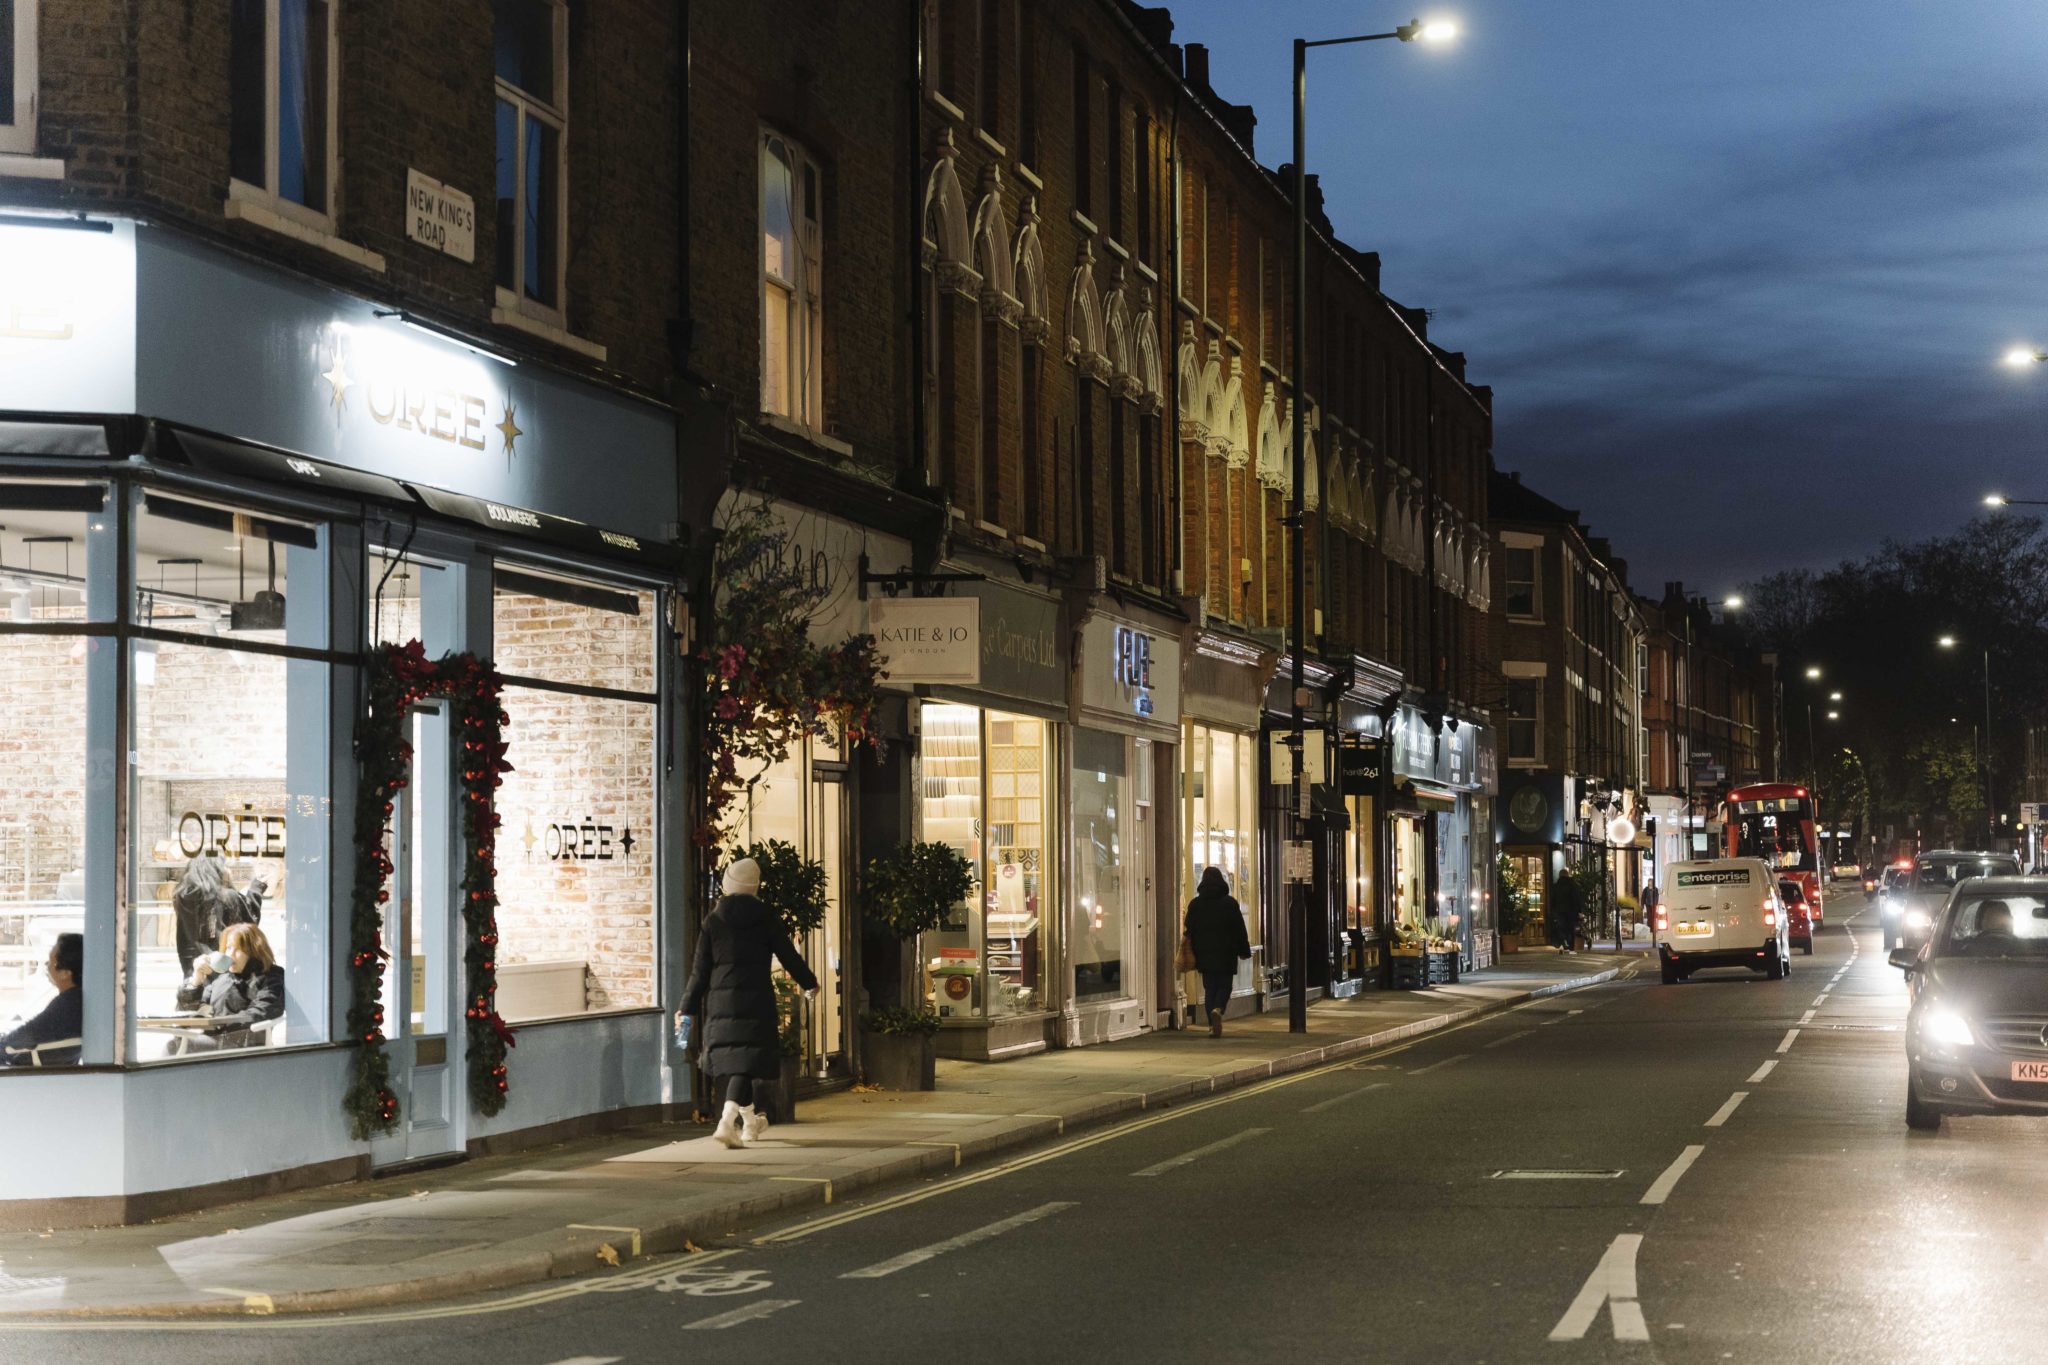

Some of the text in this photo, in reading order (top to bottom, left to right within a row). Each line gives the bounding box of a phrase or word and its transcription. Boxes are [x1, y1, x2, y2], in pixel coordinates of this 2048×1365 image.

[409, 185, 472, 233] NEW KING'S
[417, 216, 446, 247] ROAD
[880, 626, 968, 644] KATIE & JO
[997, 616, 1037, 673] Carpets
[1040, 629, 1057, 669] Ltd
[1763, 815, 1777, 828] 22
[1681, 871, 1749, 884] enterprise
